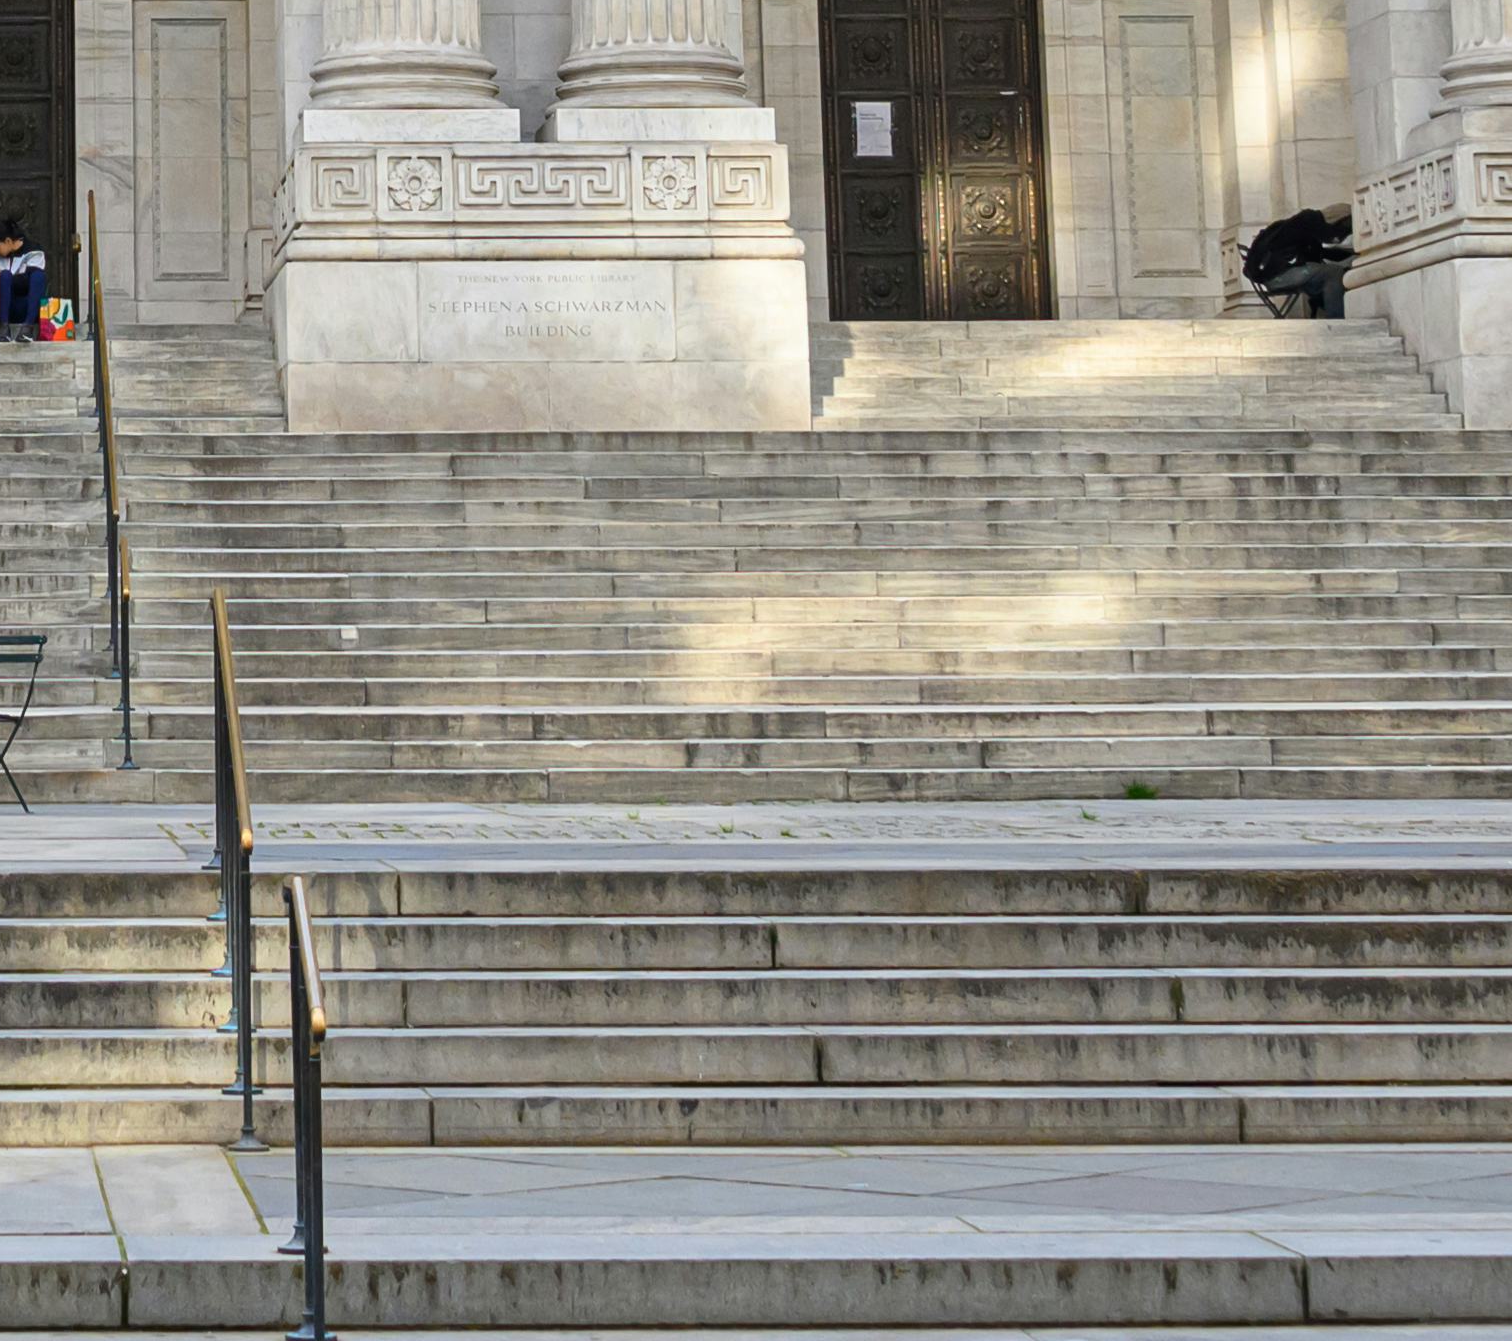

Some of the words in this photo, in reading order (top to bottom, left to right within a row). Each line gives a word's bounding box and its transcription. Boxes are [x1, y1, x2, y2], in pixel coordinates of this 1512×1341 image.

[428, 301, 512, 314] STEPHEN
[518, 302, 529, 313] A
[534, 300, 666, 313] SCHWARZMAN
[505, 325, 591, 337] BUILDING
